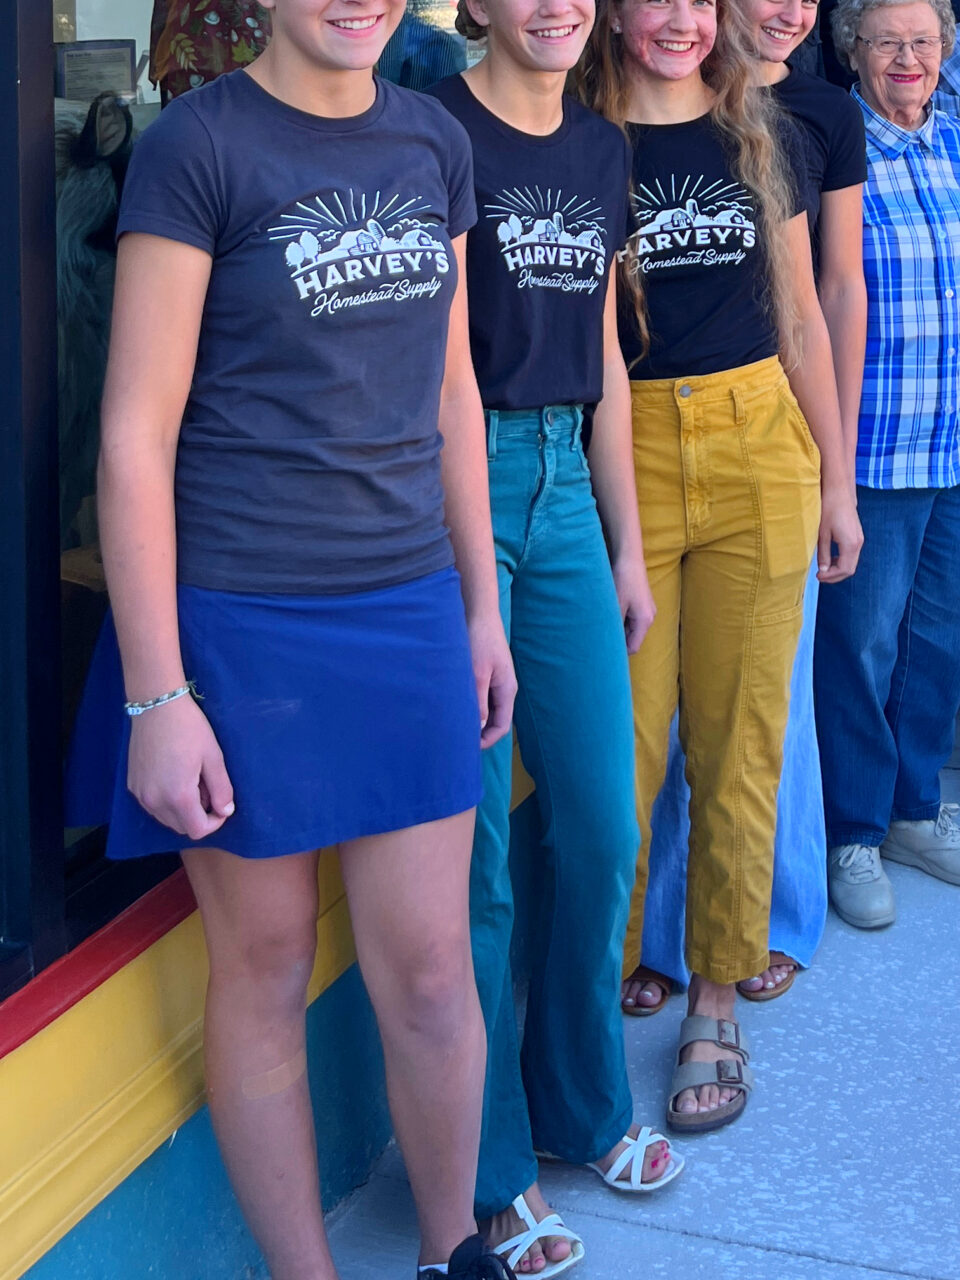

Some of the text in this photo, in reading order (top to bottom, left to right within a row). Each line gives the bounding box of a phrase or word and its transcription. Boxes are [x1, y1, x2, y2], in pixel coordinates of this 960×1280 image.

[504, 245, 605, 276] HARVEY'S
[702, 249, 747, 265] Supply
[293, 251, 450, 300] HARVEY'S
[562, 272, 599, 295] Supply
[310, 276, 442, 317] Homestead Supply
